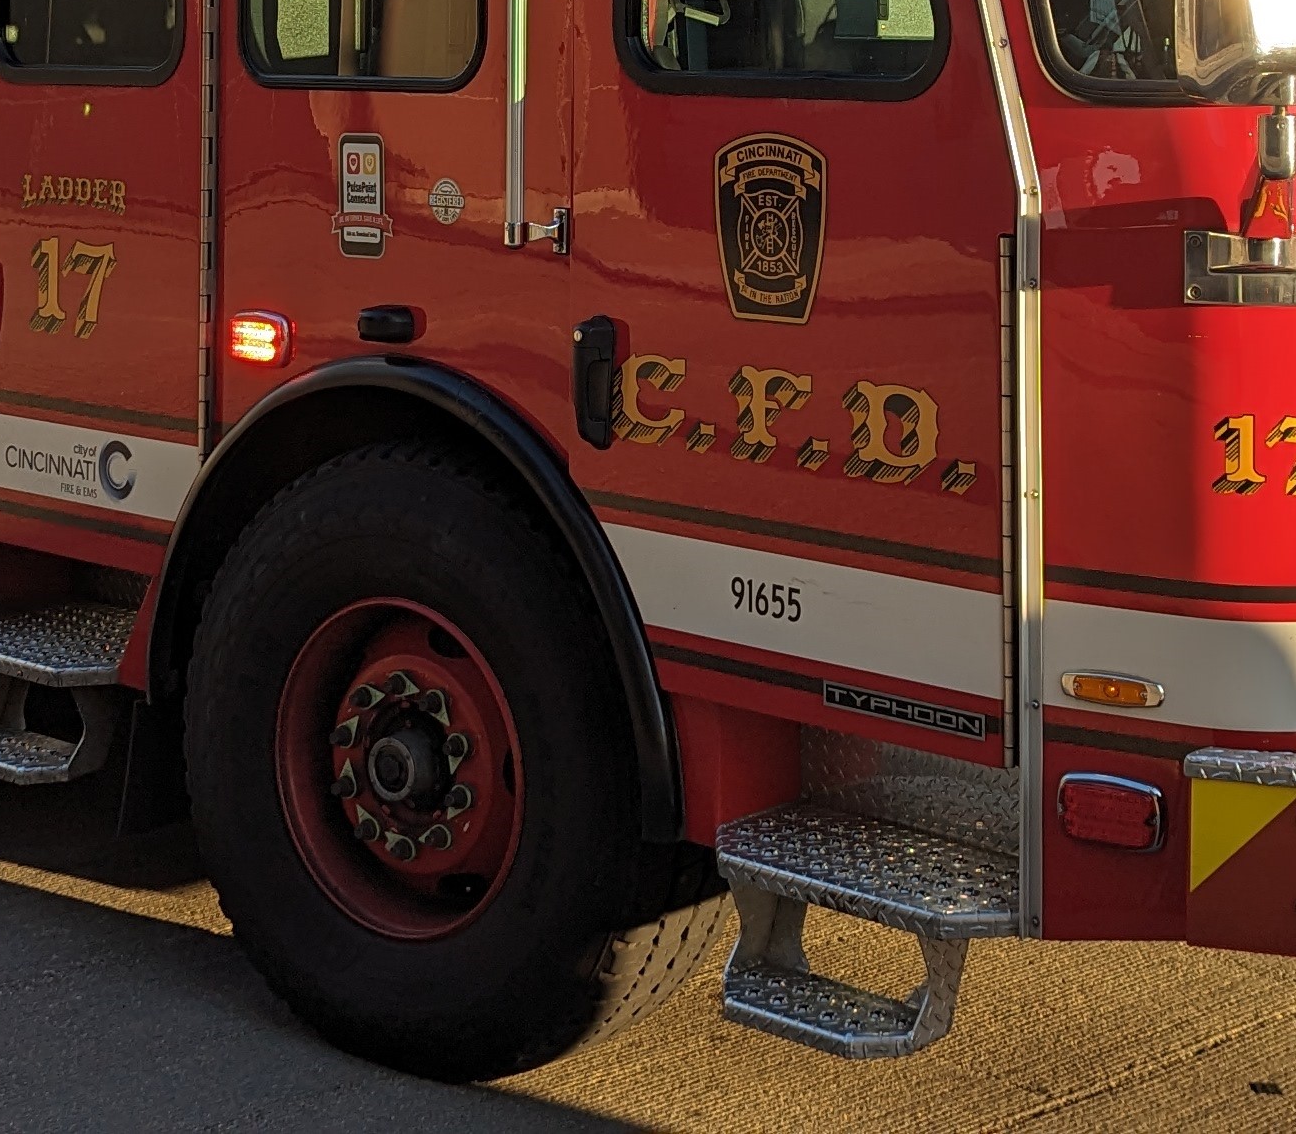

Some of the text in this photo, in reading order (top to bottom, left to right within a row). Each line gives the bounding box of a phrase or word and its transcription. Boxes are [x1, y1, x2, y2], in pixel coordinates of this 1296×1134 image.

[736, 145, 803, 165] CINCINNATI
[742, 168, 798, 183] FIRE DEPARTMENT
[21, 174, 126, 215] LADDER
[346, 192, 377, 204] Connected
[758, 195, 782, 207] EST.
[756, 261, 784, 273] 1853
[29, 236, 117, 339] 17
[749, 290, 757, 300] IN
[759, 292, 772, 304] THE
[775, 289, 800, 304] NATION
[73, 443, 98, 458] city of
[5, 445, 97, 482] CINCINNATI
[60, 483, 98, 499] FIRE & EMS
[731, 576, 802, 622] 91655
[827, 687, 980, 734] TYPHOON
